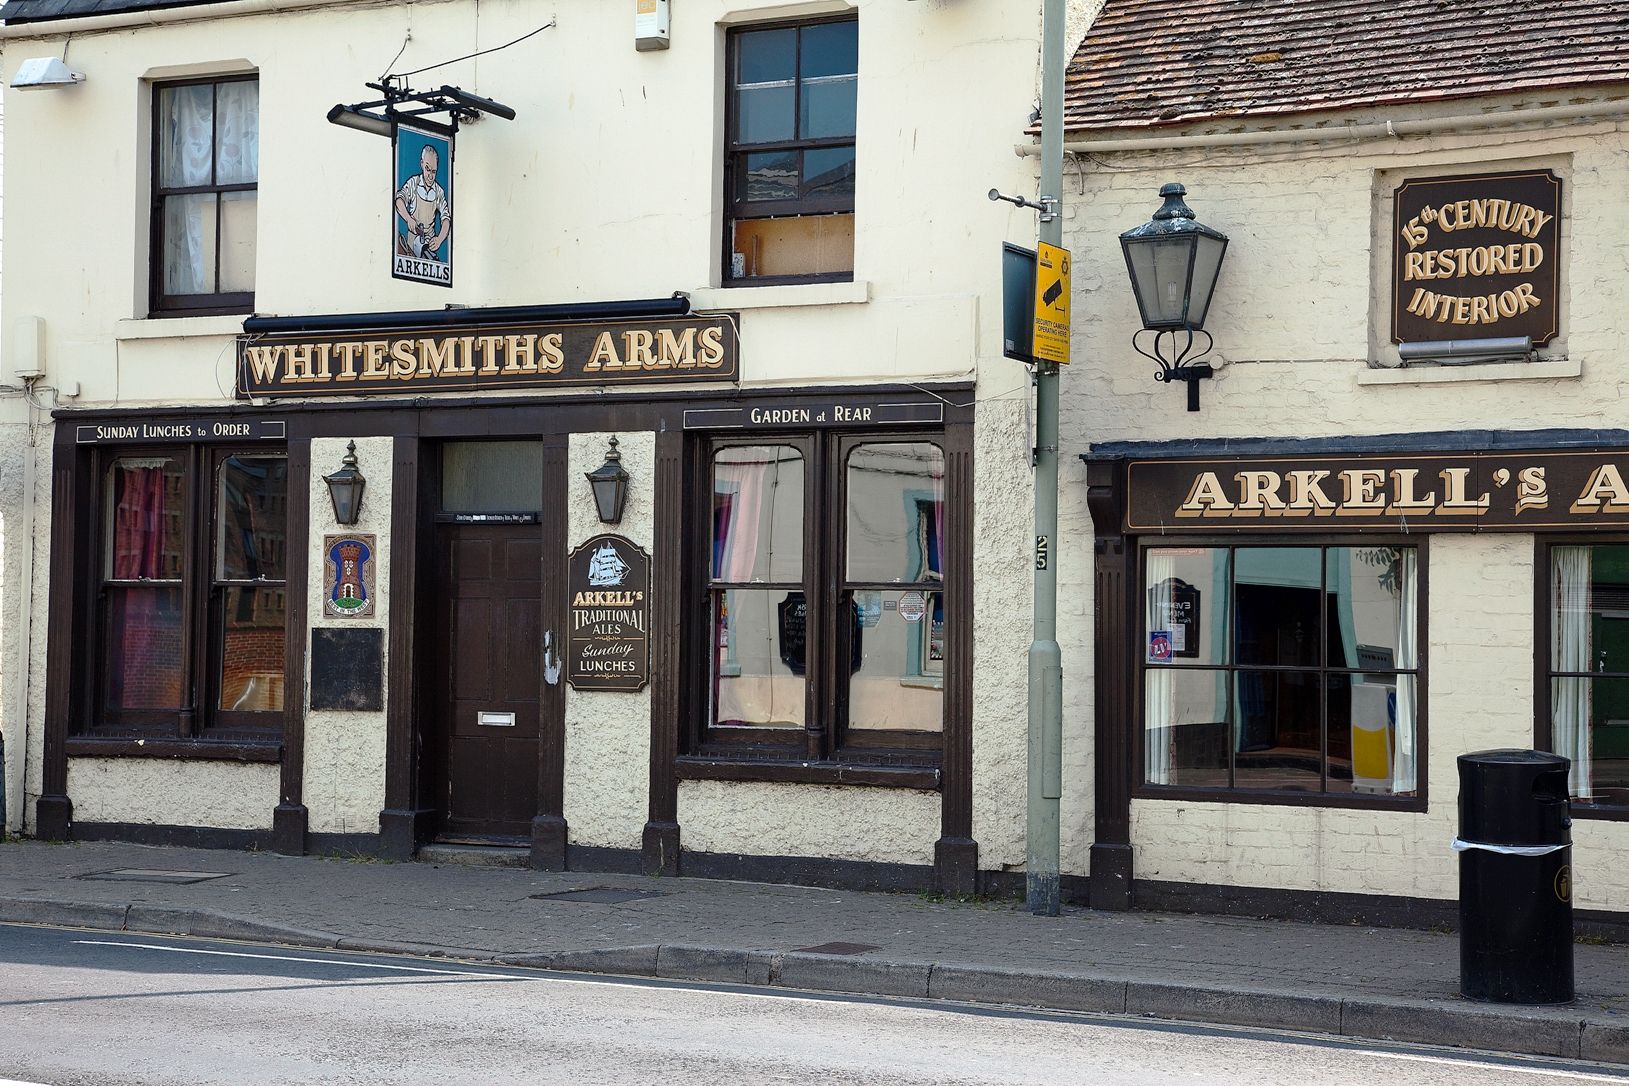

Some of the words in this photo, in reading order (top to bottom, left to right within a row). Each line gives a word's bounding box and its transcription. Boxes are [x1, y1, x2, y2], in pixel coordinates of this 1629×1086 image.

[1401, 204, 1438, 250] 15th
[1437, 199, 1553, 239] CENTURY
[396, 258, 450, 280] ARKELLS
[1404, 242, 1544, 281] RESTORED
[1406, 282, 1541, 324] INTERIOR
[1036, 318, 1053, 327] SECURITY
[1037, 325, 1057, 335] OPERATING
[1058, 330, 1067, 338] HERE
[247, 332, 564, 385] WHITESMITHS
[583, 326, 725, 372] ARMS
[750, 408, 810, 424] GARDEN
[816, 411, 826, 422] at
[834, 406, 872, 421] REAR
[96, 425, 139, 439] SUNDAY
[143, 424, 192, 438] LUNCHES
[197, 426, 206, 437] to
[213, 422, 250, 436] ORDER
[1174, 466, 1549, 518] ARKELL'S
[1037, 536, 1047, 569] 25
[572, 590, 643, 606] ARKELL'S
[572, 609, 645, 633] TRADITIONAL
[592, 624, 621, 635] ALES
[581, 642, 635, 658] Sunday
[580, 660, 636, 671] LUNCHES
